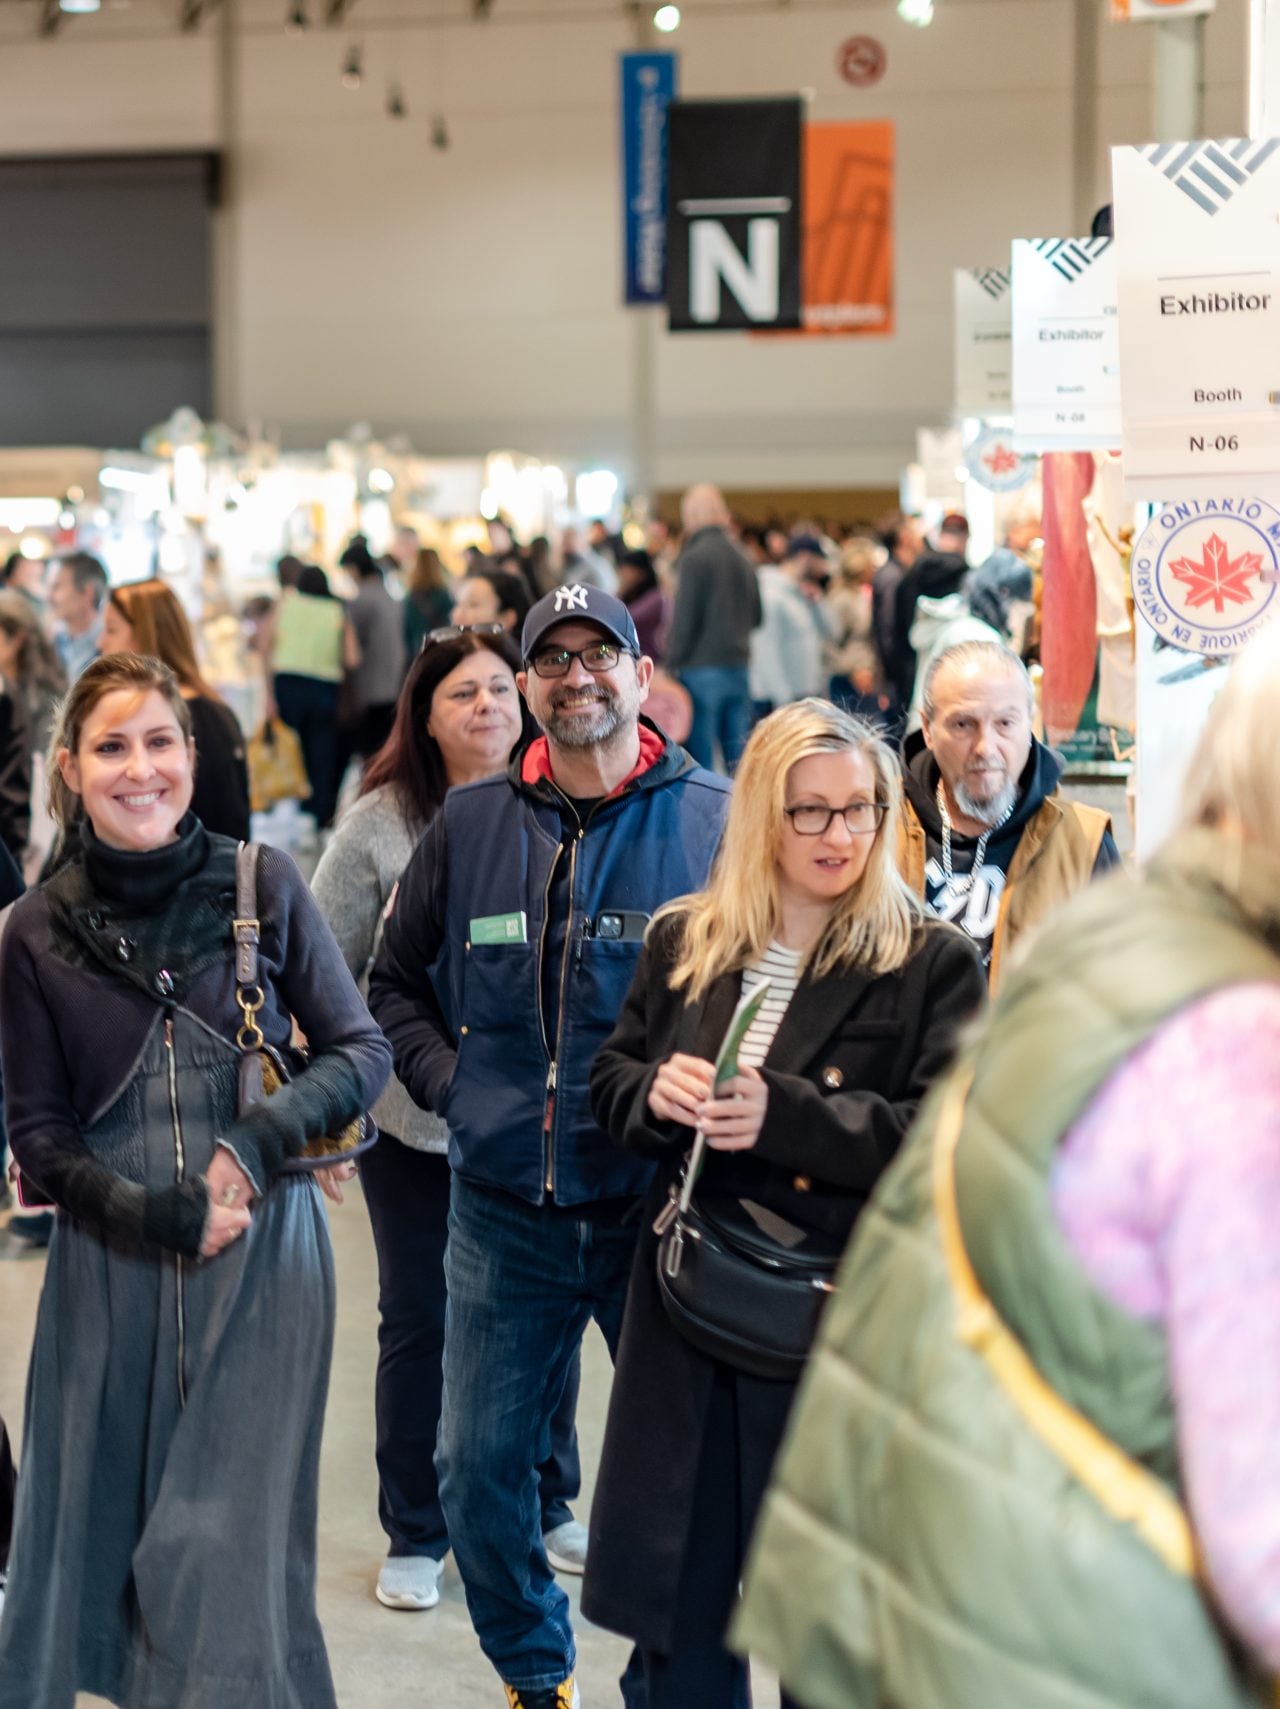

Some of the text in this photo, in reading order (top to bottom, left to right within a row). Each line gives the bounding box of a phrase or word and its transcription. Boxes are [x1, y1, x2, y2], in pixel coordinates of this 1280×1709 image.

[688, 216, 780, 322] N
[1159, 291, 1271, 316] Exhibitor
[1038, 329, 1104, 342] Exhibitor
[1194, 387, 1242, 403] Booth
[1189, 434, 1240, 452] N-06
[1160, 498, 1261, 529] ONTARIO
[1137, 558, 1168, 624] ONTARIO
[1171, 624, 1192, 643] EN
